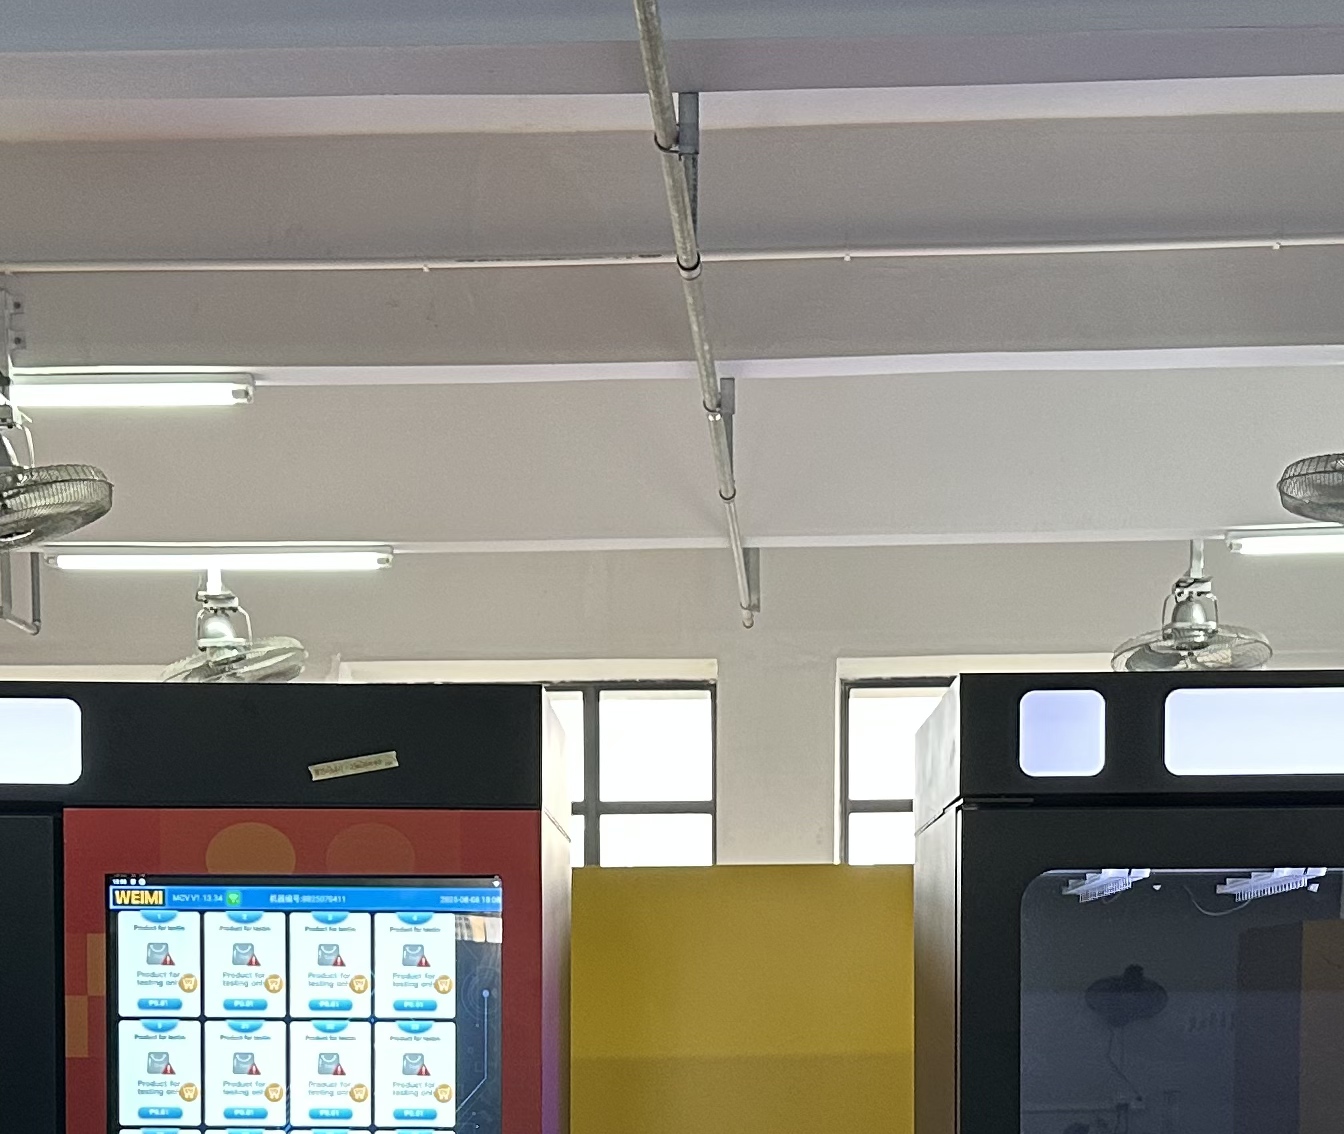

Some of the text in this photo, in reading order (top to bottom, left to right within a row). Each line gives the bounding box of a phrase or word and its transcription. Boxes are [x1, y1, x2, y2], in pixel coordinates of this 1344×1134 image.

[114, 890, 164, 905] WEIMI
[137, 971, 181, 979] Product for
[223, 971, 267, 979] Product for
[308, 971, 352, 979] Product for
[392, 971, 436, 979] Product for
[137, 1080, 181, 1088] Product for
[223, 1080, 267, 1088] Product for
[308, 1080, 352, 1088] Product for
[392, 1080, 436, 1088] Product for
